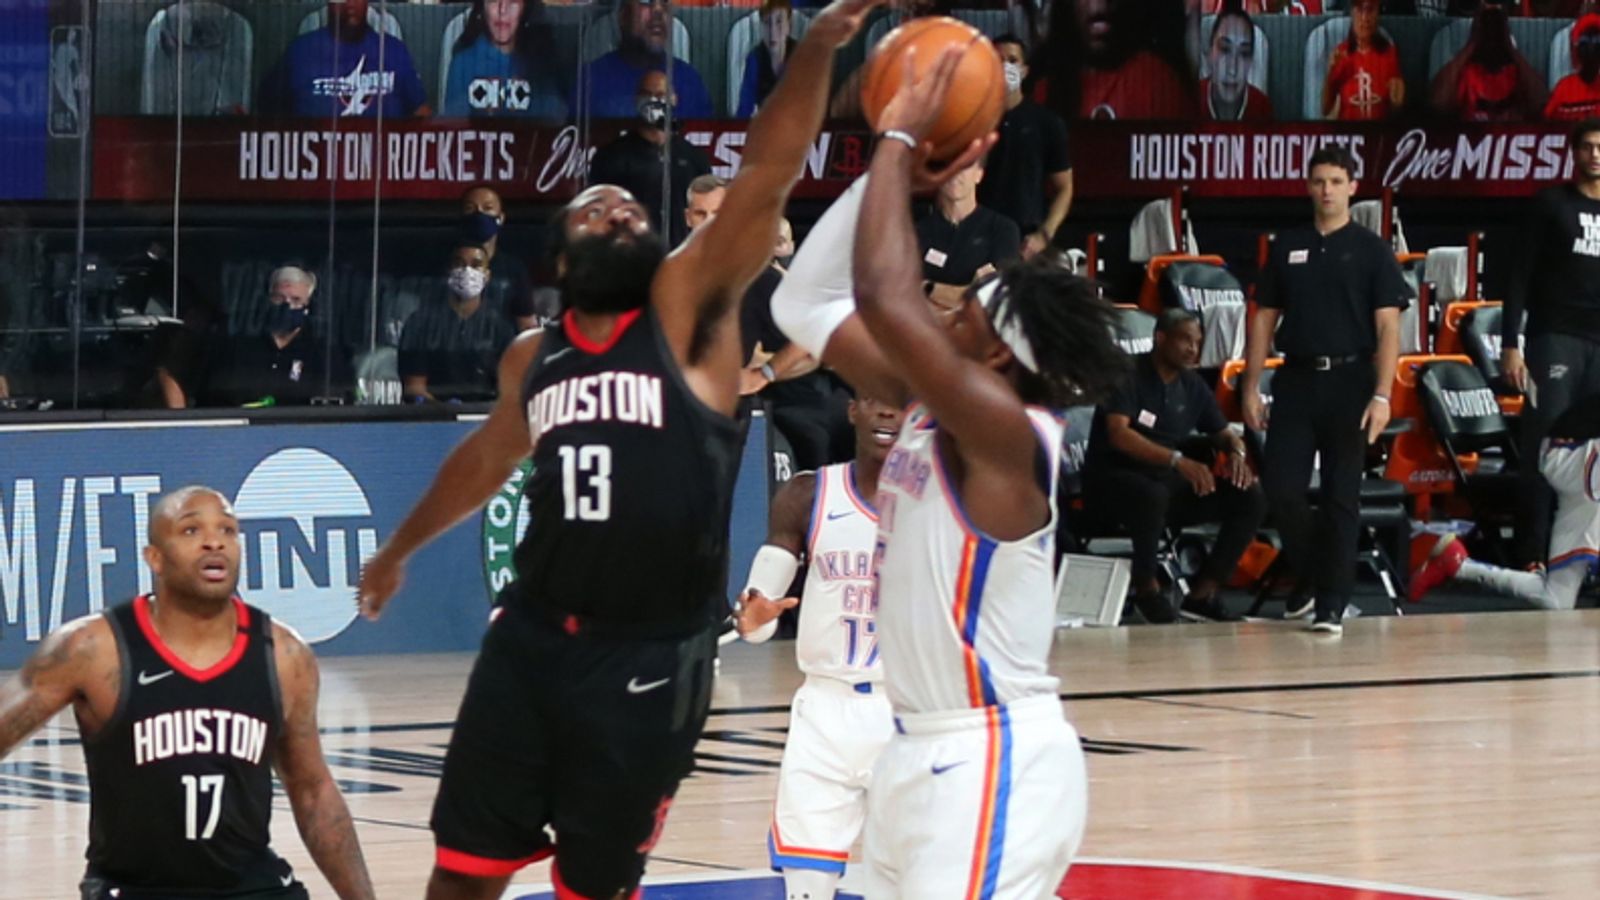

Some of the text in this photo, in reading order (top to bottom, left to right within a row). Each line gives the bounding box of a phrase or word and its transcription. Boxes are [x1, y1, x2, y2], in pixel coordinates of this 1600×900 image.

[468, 79, 530, 110] OKC
[239, 131, 514, 181] HOUSTON ROCKETS
[1130, 134, 1364, 180] HOUSTON ROCKS
[1450, 133, 1575, 180] MISSI
[373, 380, 403, 405] PLAY
[527, 371, 664, 448] HOUSTON
[558, 445, 612, 521] 13
[814, 549, 879, 582] OKLA
[841, 616, 881, 668] 17
[133, 708, 267, 765] HOUSTON
[181, 774, 225, 840] 17
